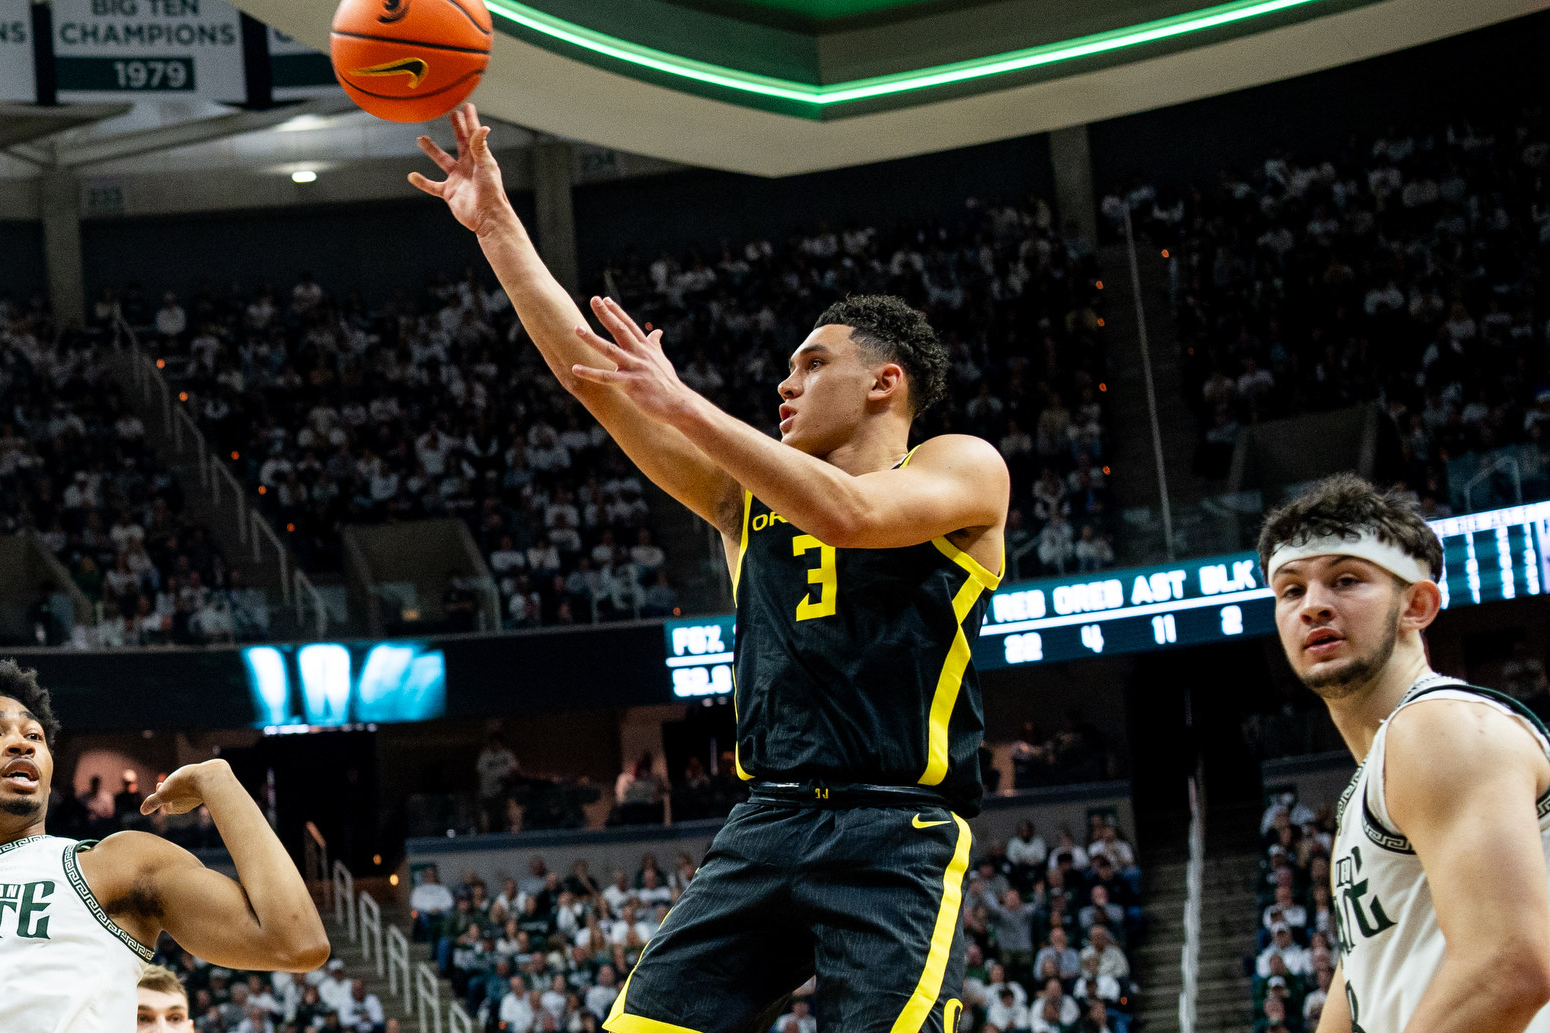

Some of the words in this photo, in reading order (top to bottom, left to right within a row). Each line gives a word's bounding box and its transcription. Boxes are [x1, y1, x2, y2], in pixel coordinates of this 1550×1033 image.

[59, 22, 236, 46] CHAMPIONS
[114, 60, 188, 88] 1979
[792, 534, 837, 621] 3
[1131, 569, 1187, 605] AST
[1199, 559, 1257, 595] BLK
[1081, 624, 1104, 653] 4
[1152, 613, 1177, 645] 11
